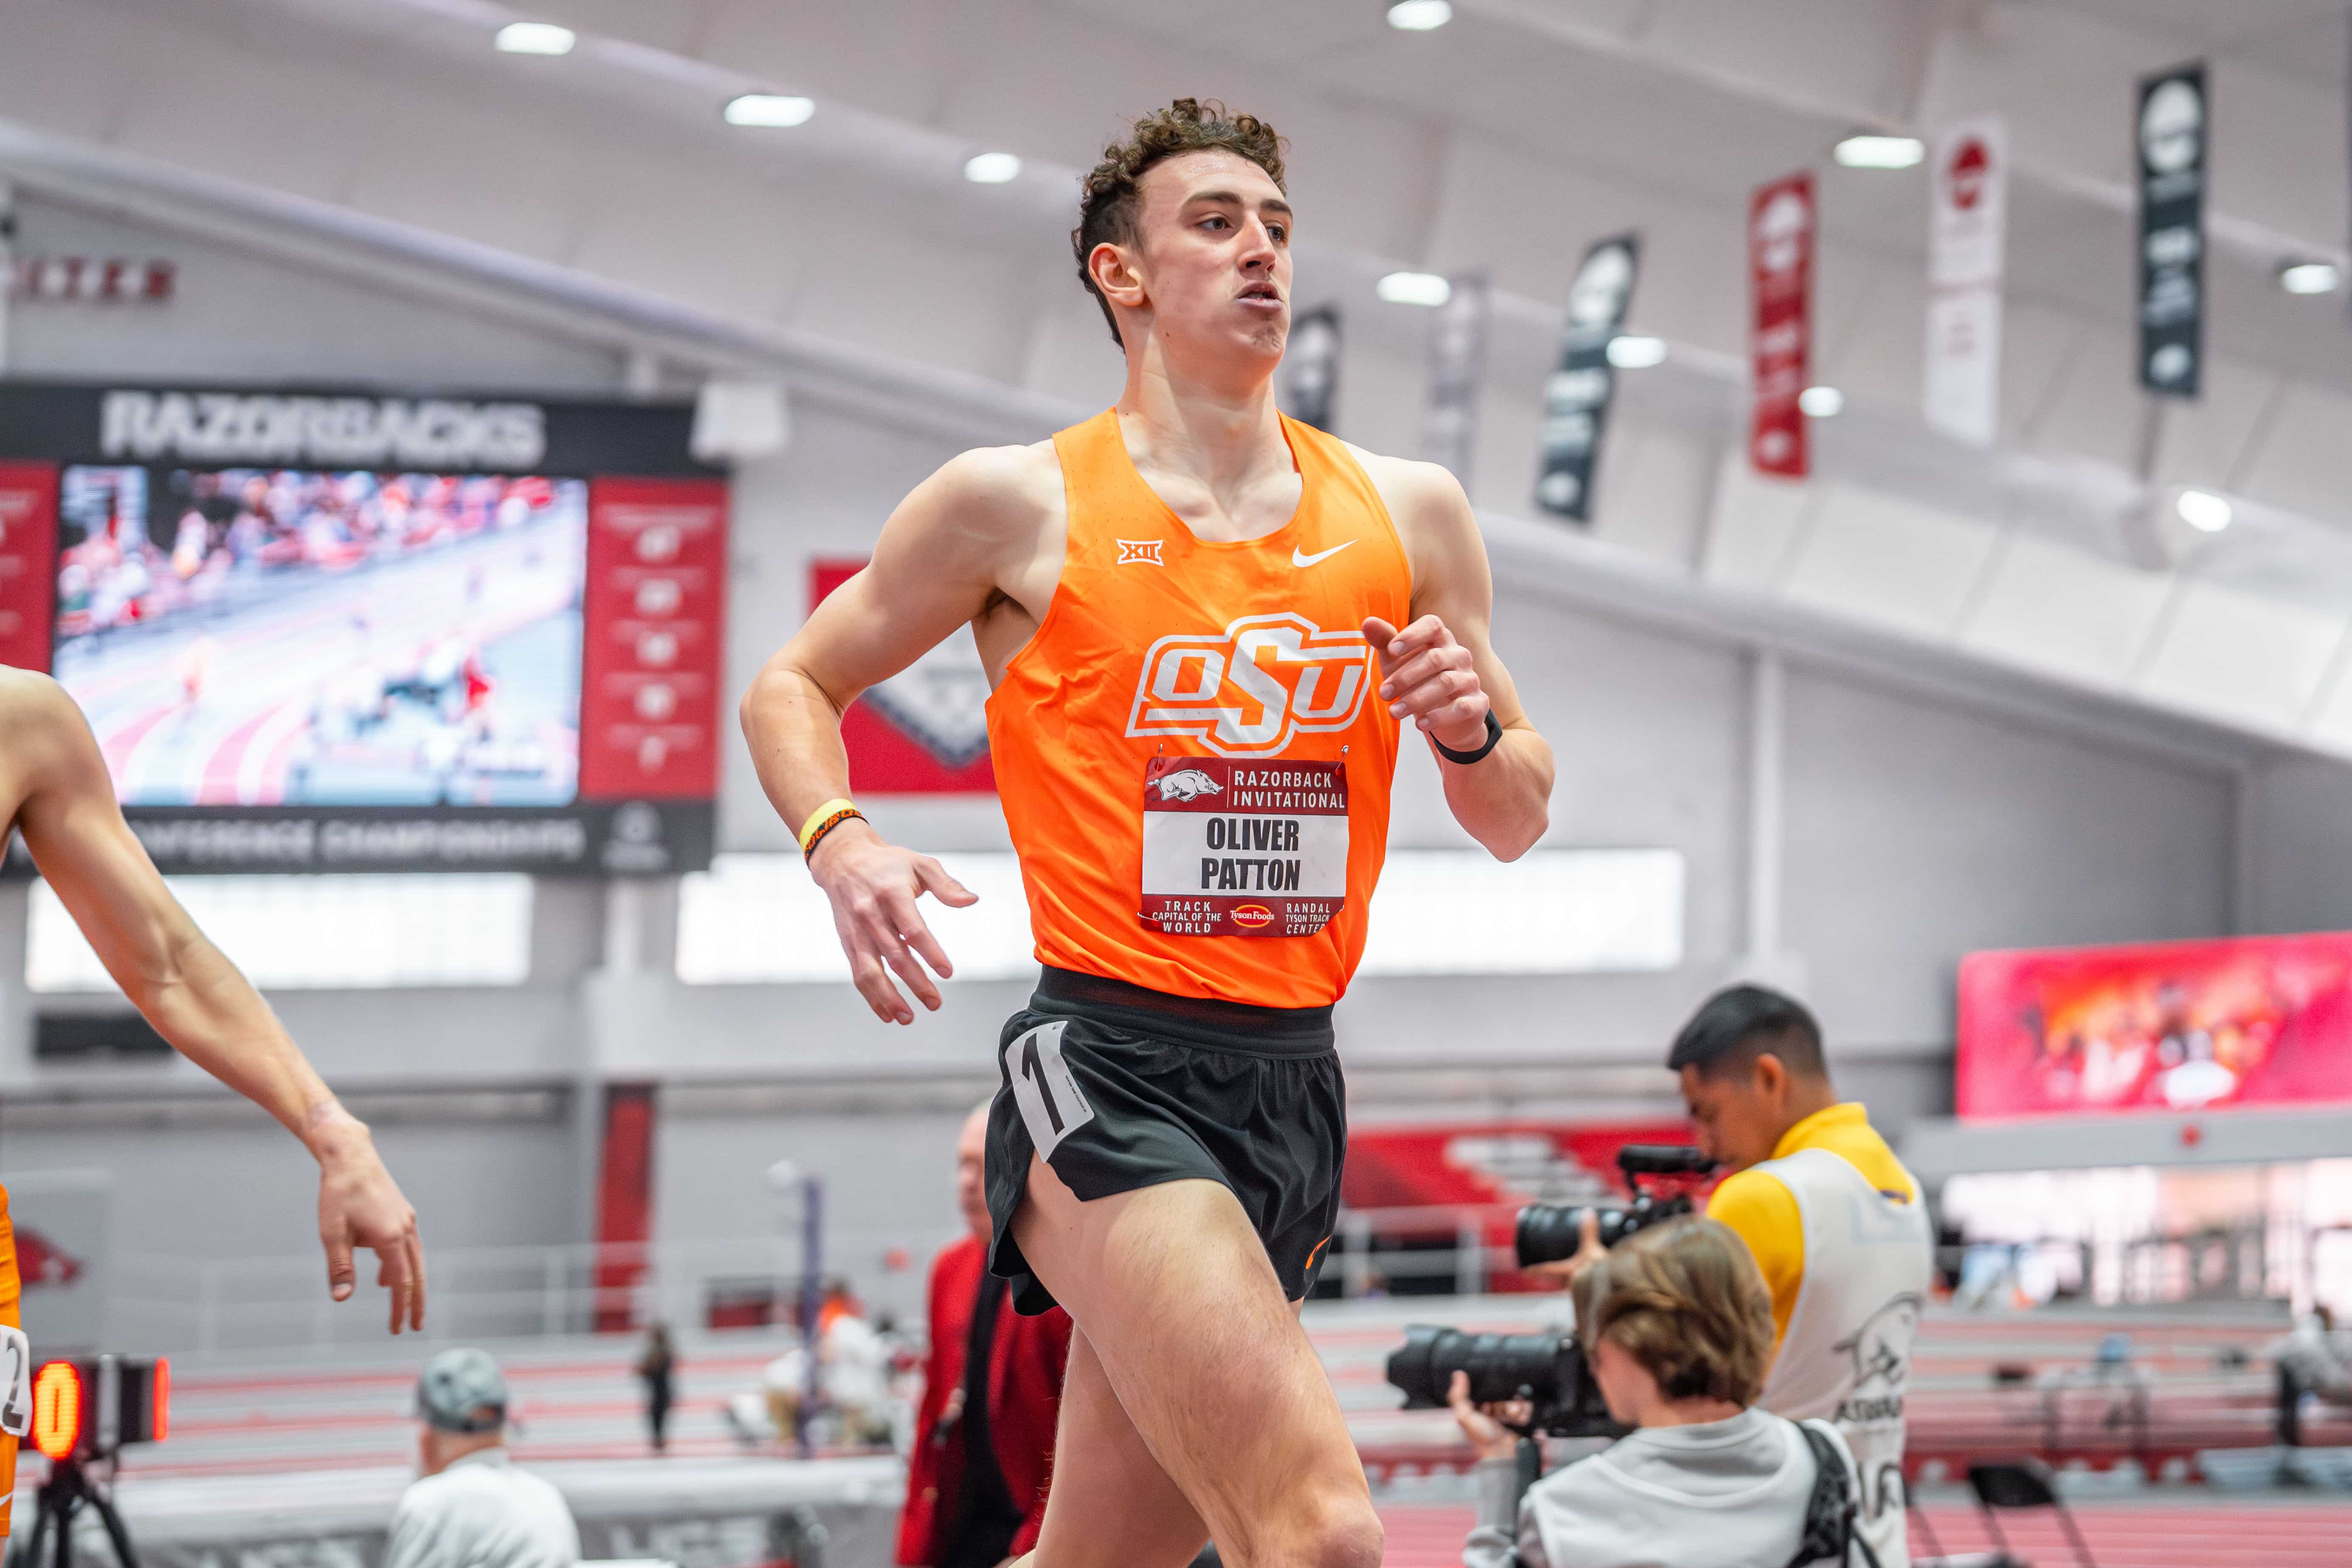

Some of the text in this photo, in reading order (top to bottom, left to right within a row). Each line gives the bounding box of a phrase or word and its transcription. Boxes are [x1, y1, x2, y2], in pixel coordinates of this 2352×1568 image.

[102, 389, 545, 469] RAZORBACKS
[1127, 613, 1374, 757] OSU
[1234, 771, 1332, 788] RAZORBACK
[1233, 791, 1345, 808] INVITATIONAL
[1206, 817, 1299, 851] OLIVER
[1201, 857, 1301, 891] PATTON
[1165, 901, 1211, 912] TRACK
[1287, 903, 1330, 913] RANDAL
[1152, 912, 1222, 921] CAPITAL OF THE
[1230, 910, 1274, 921] Tyson Foods
[1286, 914, 1330, 922] TYSON TRACK
[1163, 922, 1211, 933] WORLD
[1022, 1032, 1065, 1136] 1
[2, 1332, 23, 1429] 2
[33, 1360, 82, 1460] 0
